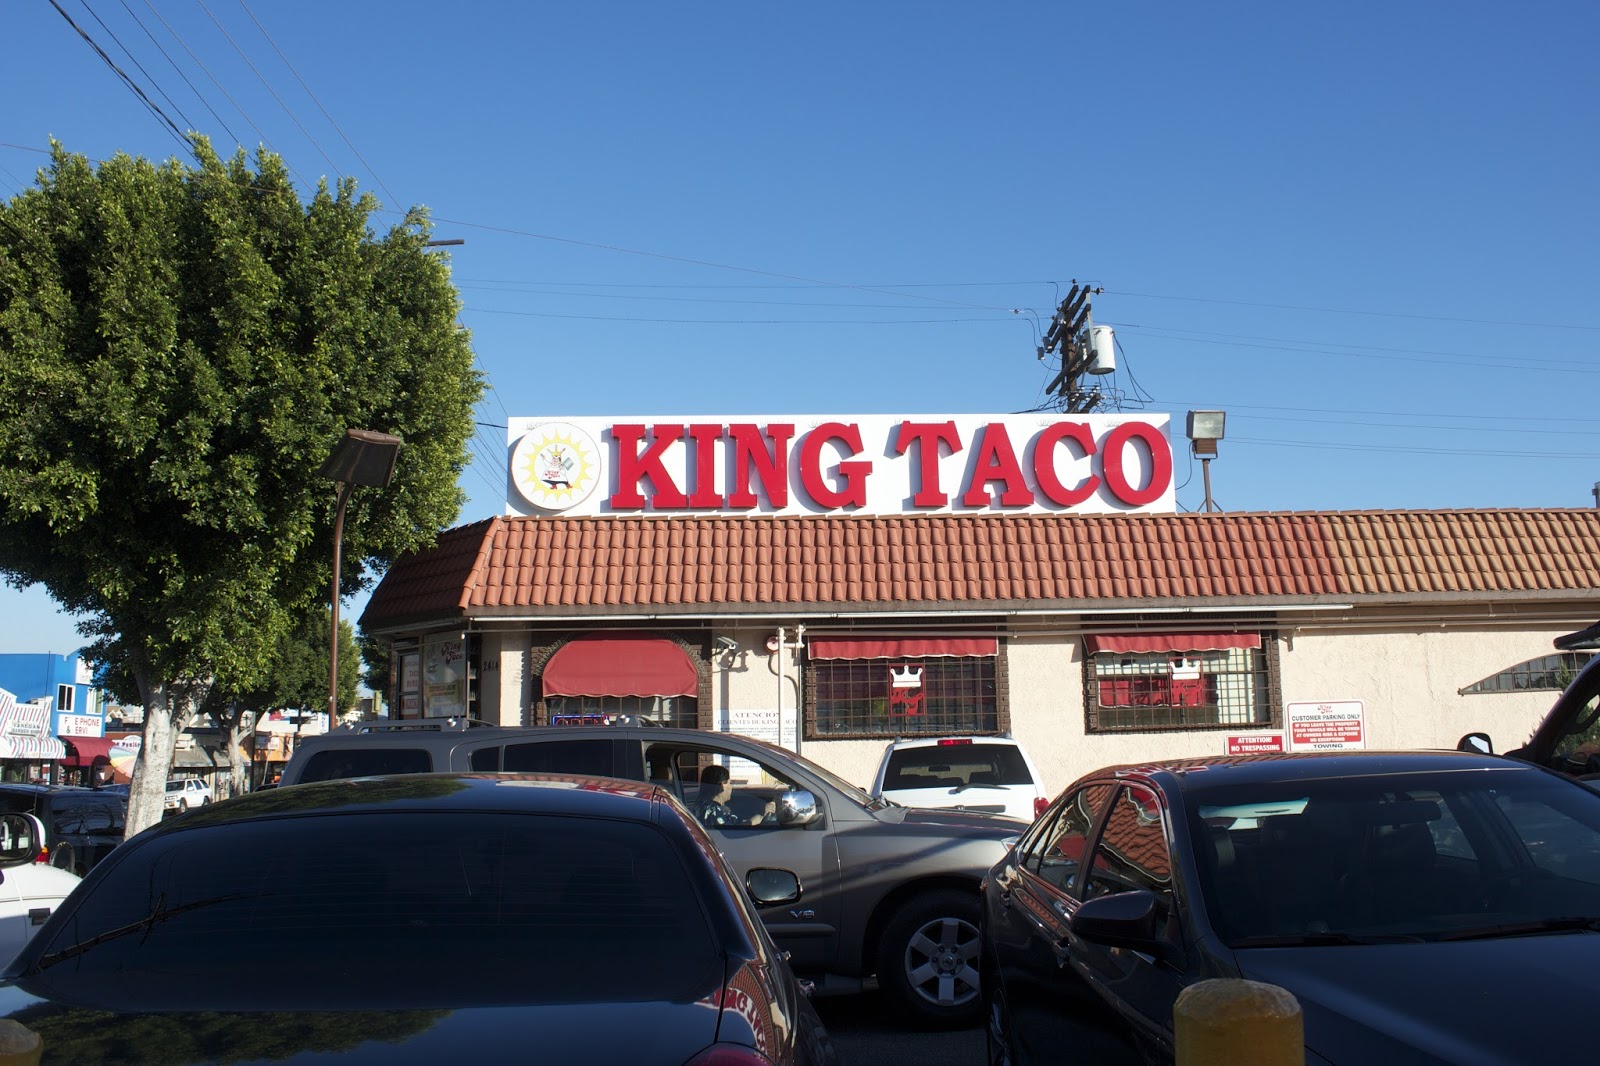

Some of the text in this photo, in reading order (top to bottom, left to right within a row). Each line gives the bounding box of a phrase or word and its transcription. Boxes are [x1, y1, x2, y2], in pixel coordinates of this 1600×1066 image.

[610, 420, 1172, 508] KING TACO
[80, 718, 99, 727] PHONE
[66, 726, 71, 734] &
